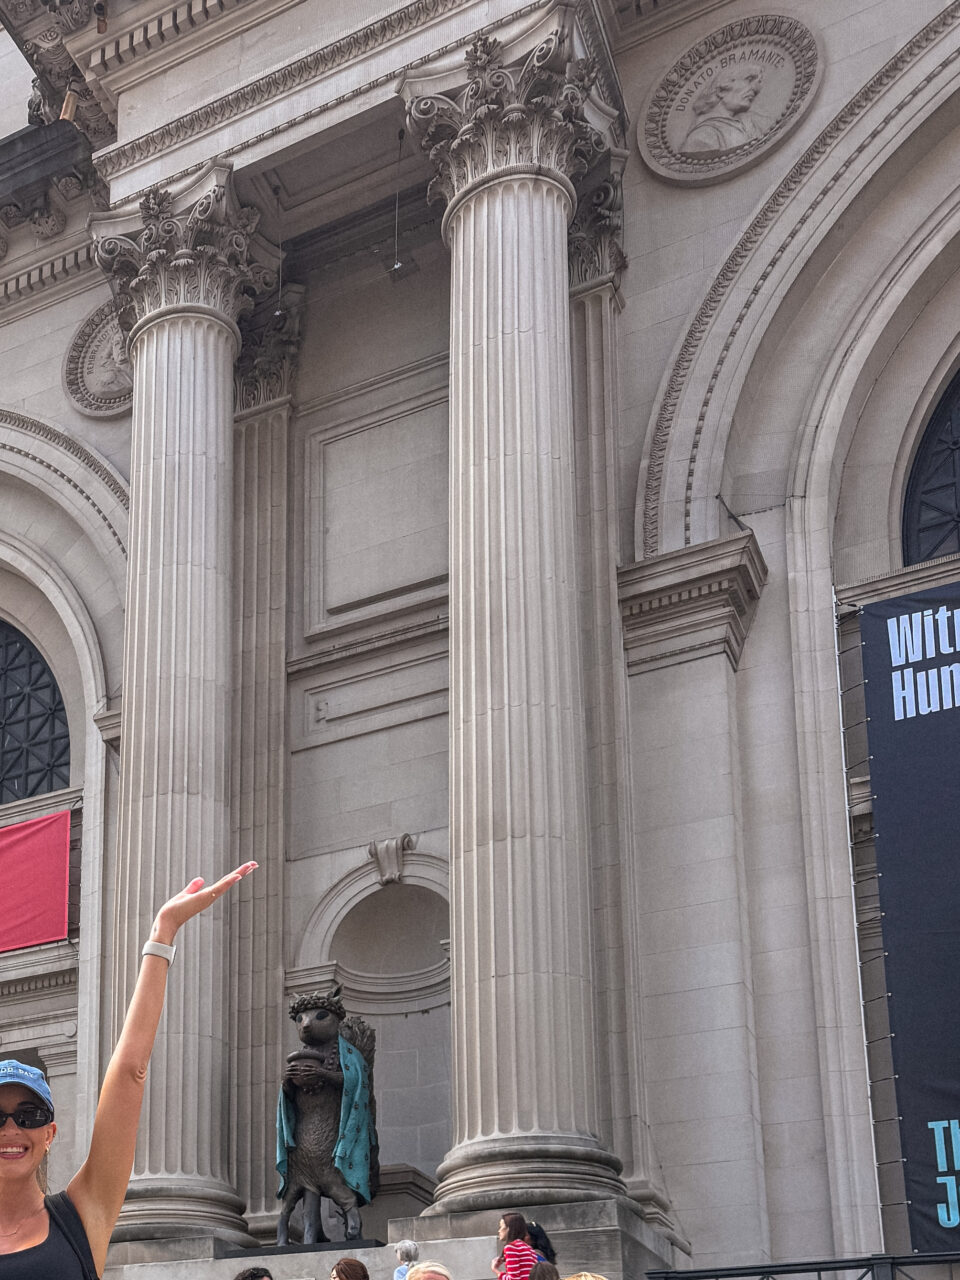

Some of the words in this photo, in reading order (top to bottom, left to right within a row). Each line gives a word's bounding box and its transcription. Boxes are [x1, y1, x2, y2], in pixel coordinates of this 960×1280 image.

[676, 67, 714, 112] DONATO
[720, 48, 785, 69] BRAMANTE
[887, 605, 960, 667] Wit
